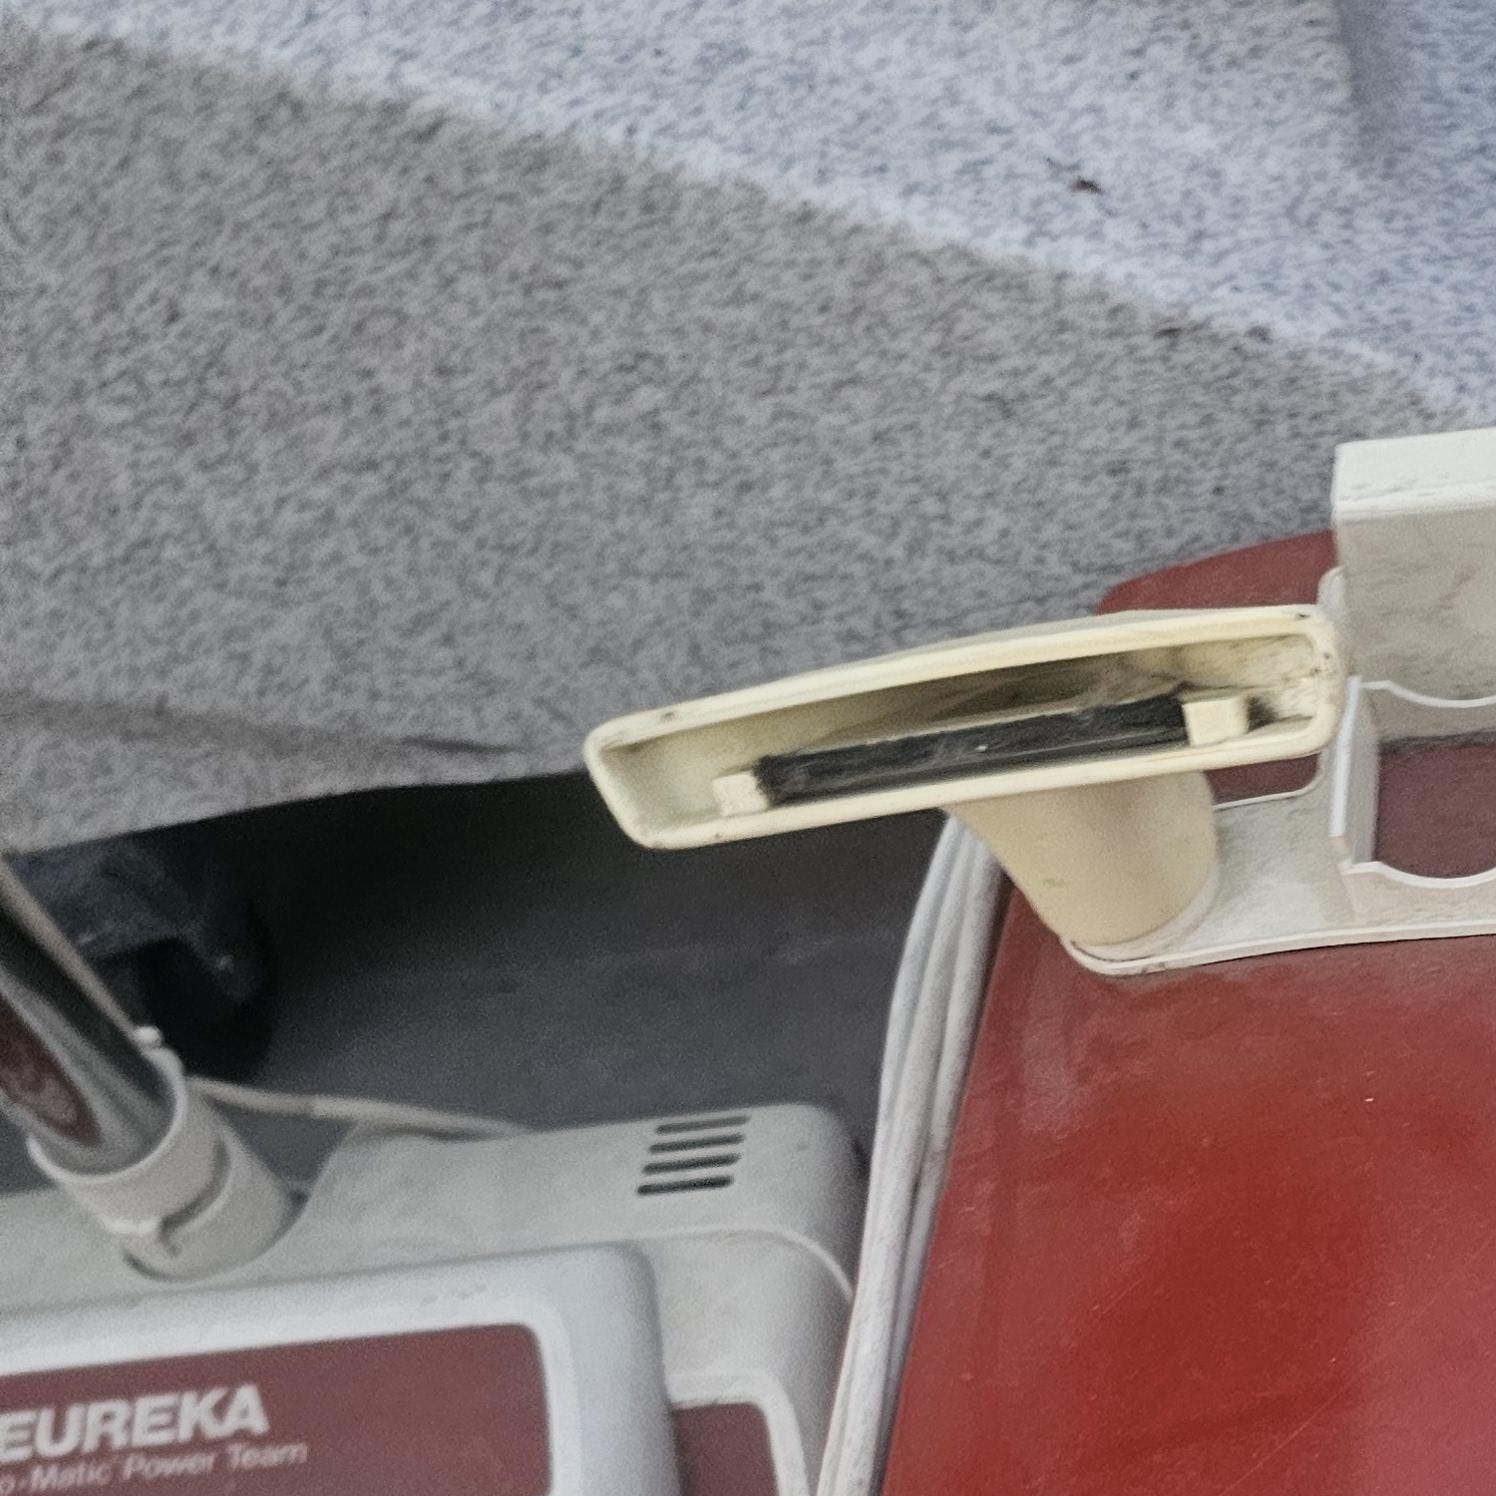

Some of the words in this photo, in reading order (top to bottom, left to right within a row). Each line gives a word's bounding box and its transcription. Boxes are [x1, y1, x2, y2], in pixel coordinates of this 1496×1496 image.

[0, 1383, 270, 1463] EUREKA
[122, 1453, 215, 1481] Power
[226, 1442, 309, 1470] Team
